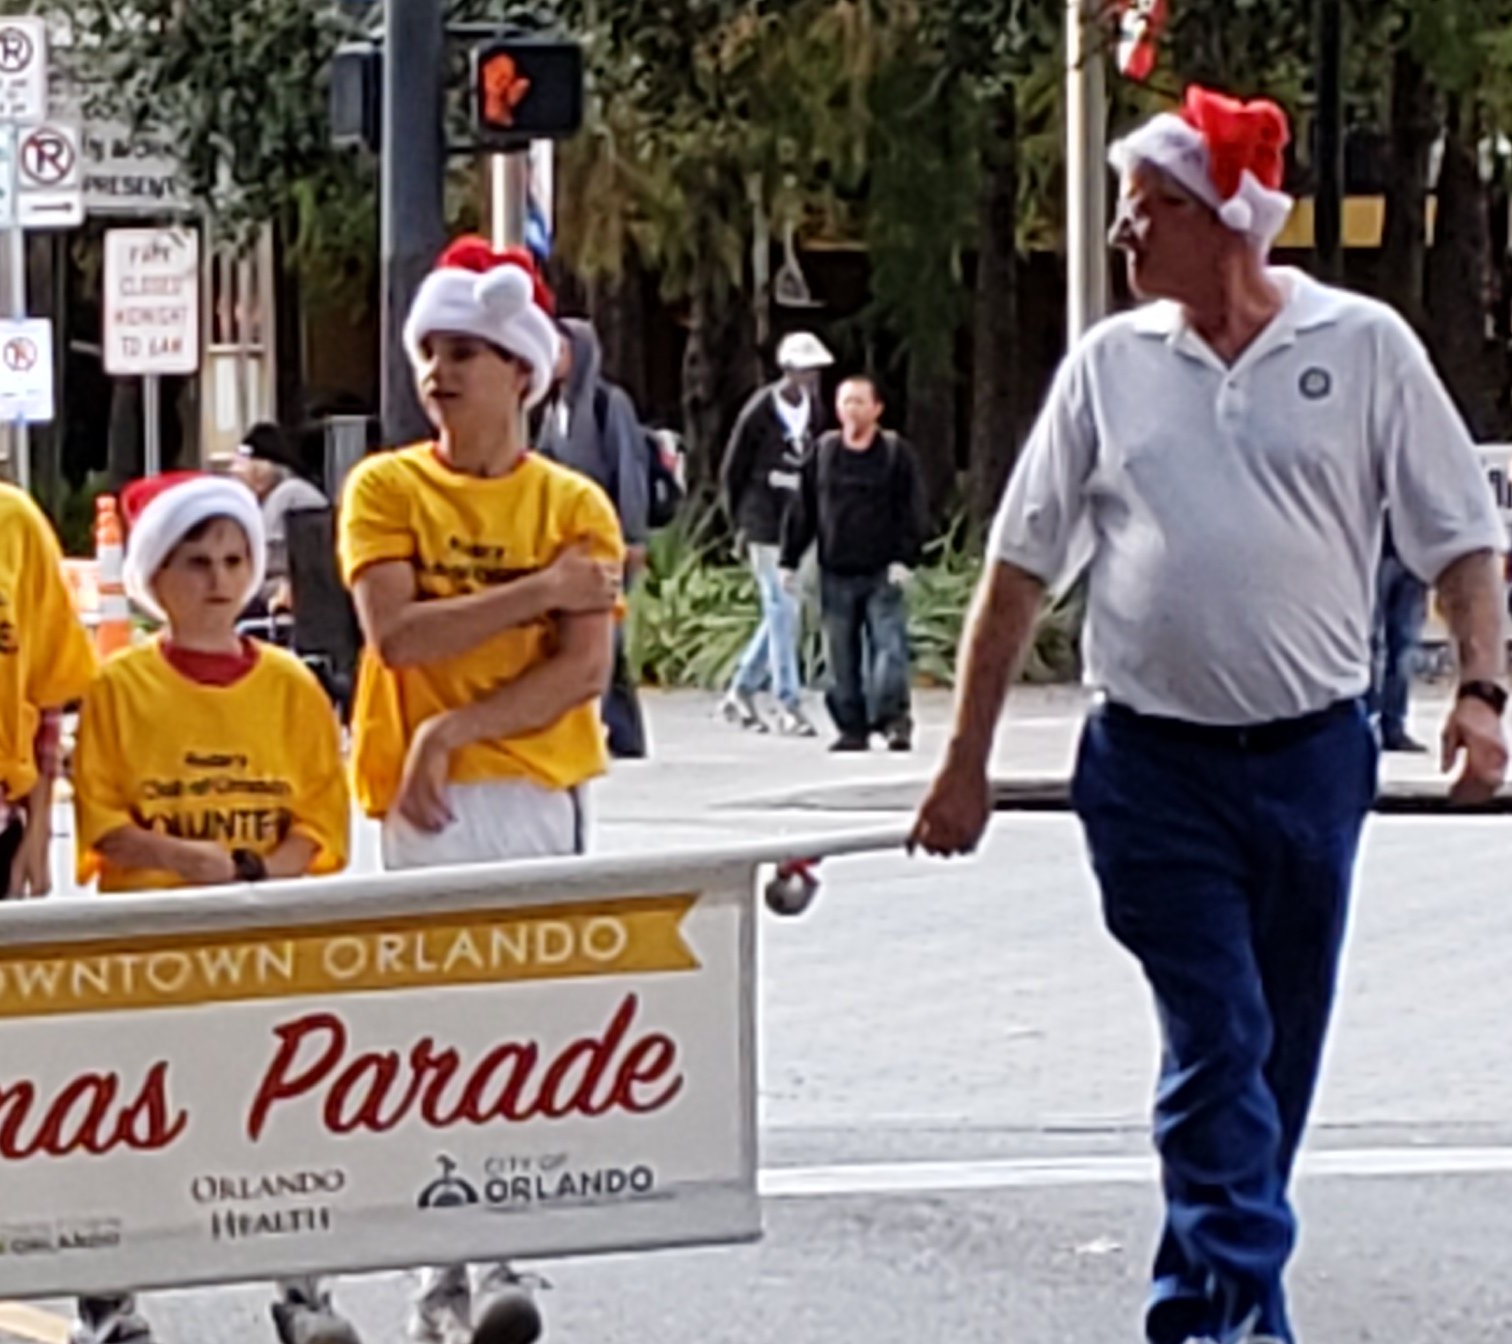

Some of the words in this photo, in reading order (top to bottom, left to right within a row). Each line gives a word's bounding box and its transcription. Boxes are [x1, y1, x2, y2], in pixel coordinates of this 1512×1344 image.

[322, 914, 627, 978] ORLANDO
[246, 991, 684, 1143] Parade
[191, 1168, 345, 1203] ORLANDO
[485, 1165, 654, 1203] ORLANDO
[211, 1207, 330, 1242] HEALTH
